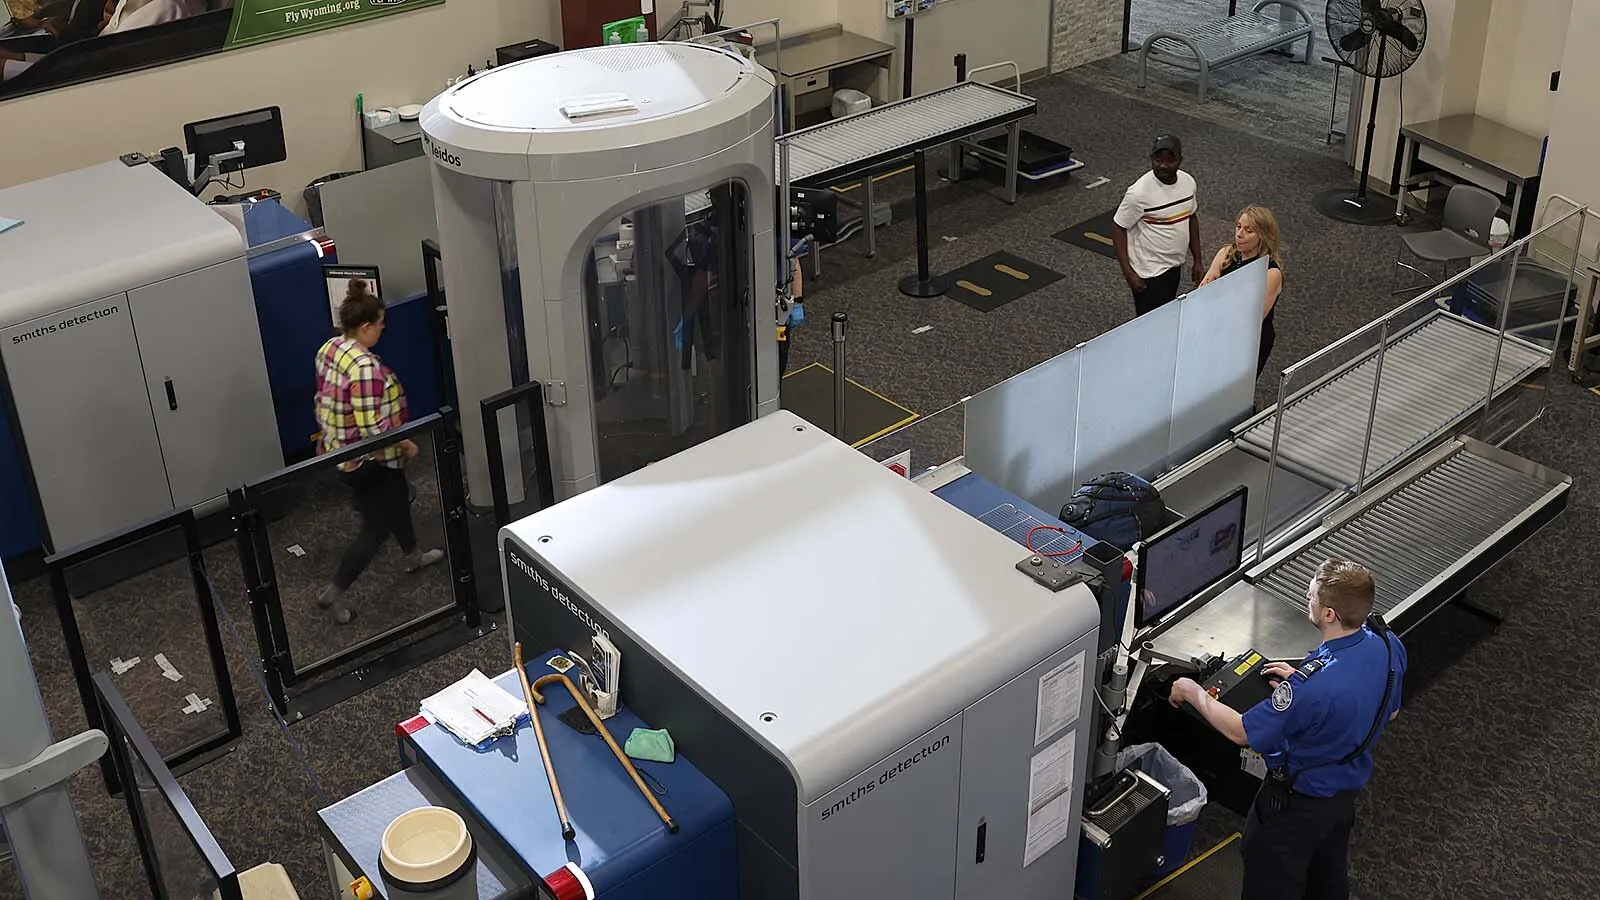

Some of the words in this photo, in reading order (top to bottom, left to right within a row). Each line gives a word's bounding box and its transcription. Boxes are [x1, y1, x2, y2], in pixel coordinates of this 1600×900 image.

[431, 142, 462, 167] leidos
[12, 325, 57, 344] smiths
[59, 306, 119, 330] detection
[510, 552, 550, 592] smiths
[821, 781, 876, 820] smiths
[879, 735, 950, 785] detection
